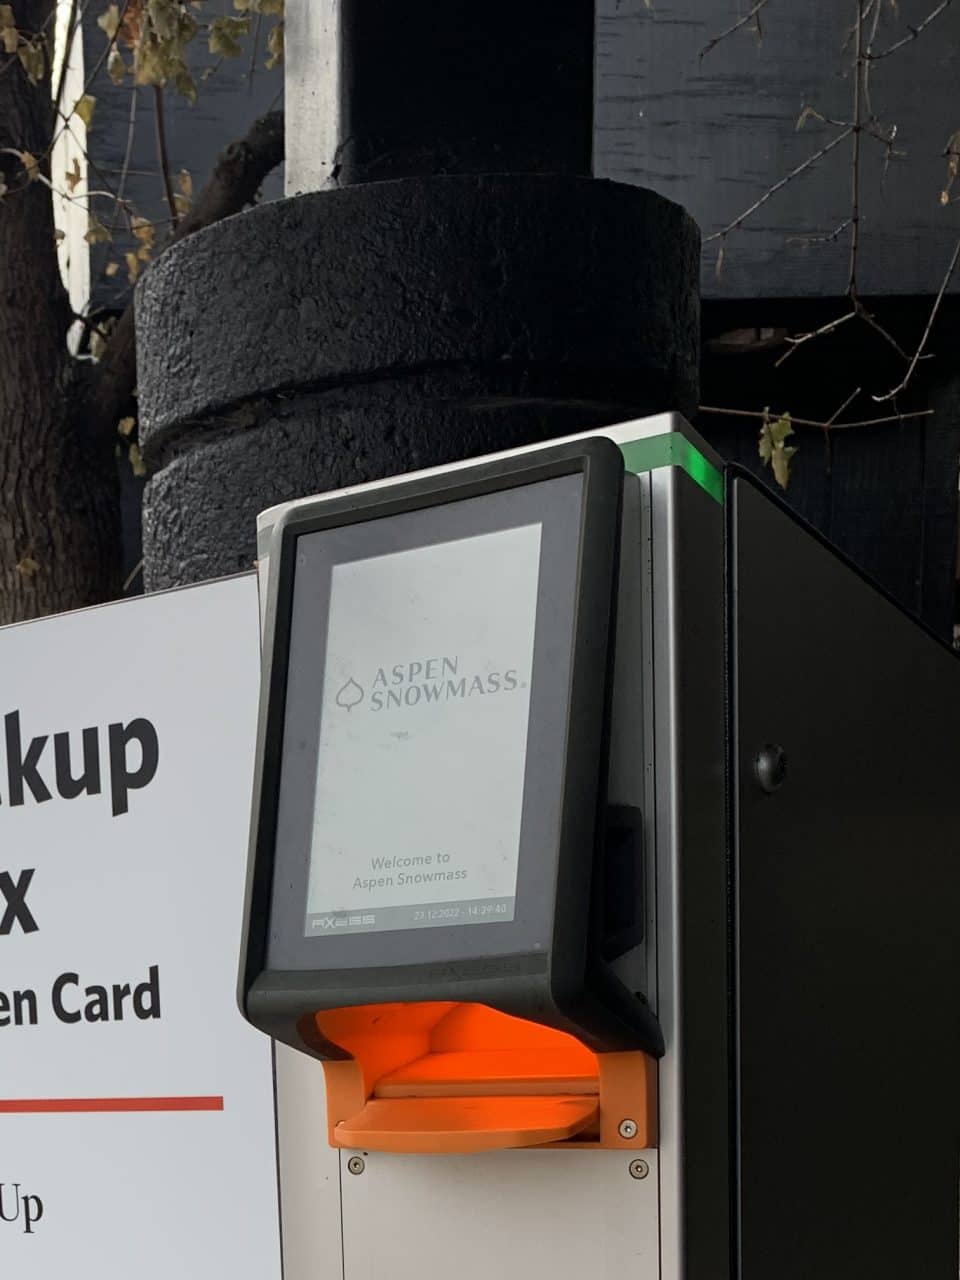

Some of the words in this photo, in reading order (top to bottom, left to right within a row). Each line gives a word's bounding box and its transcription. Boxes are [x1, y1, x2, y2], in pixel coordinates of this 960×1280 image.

[372, 655, 459, 689] ASPEN
[371, 856, 432, 870] Welcome
[437, 852, 451, 864] to
[352, 876, 393, 891] Aspen
[397, 869, 467, 886] Snowmass
[50, 964, 161, 1025] Card
